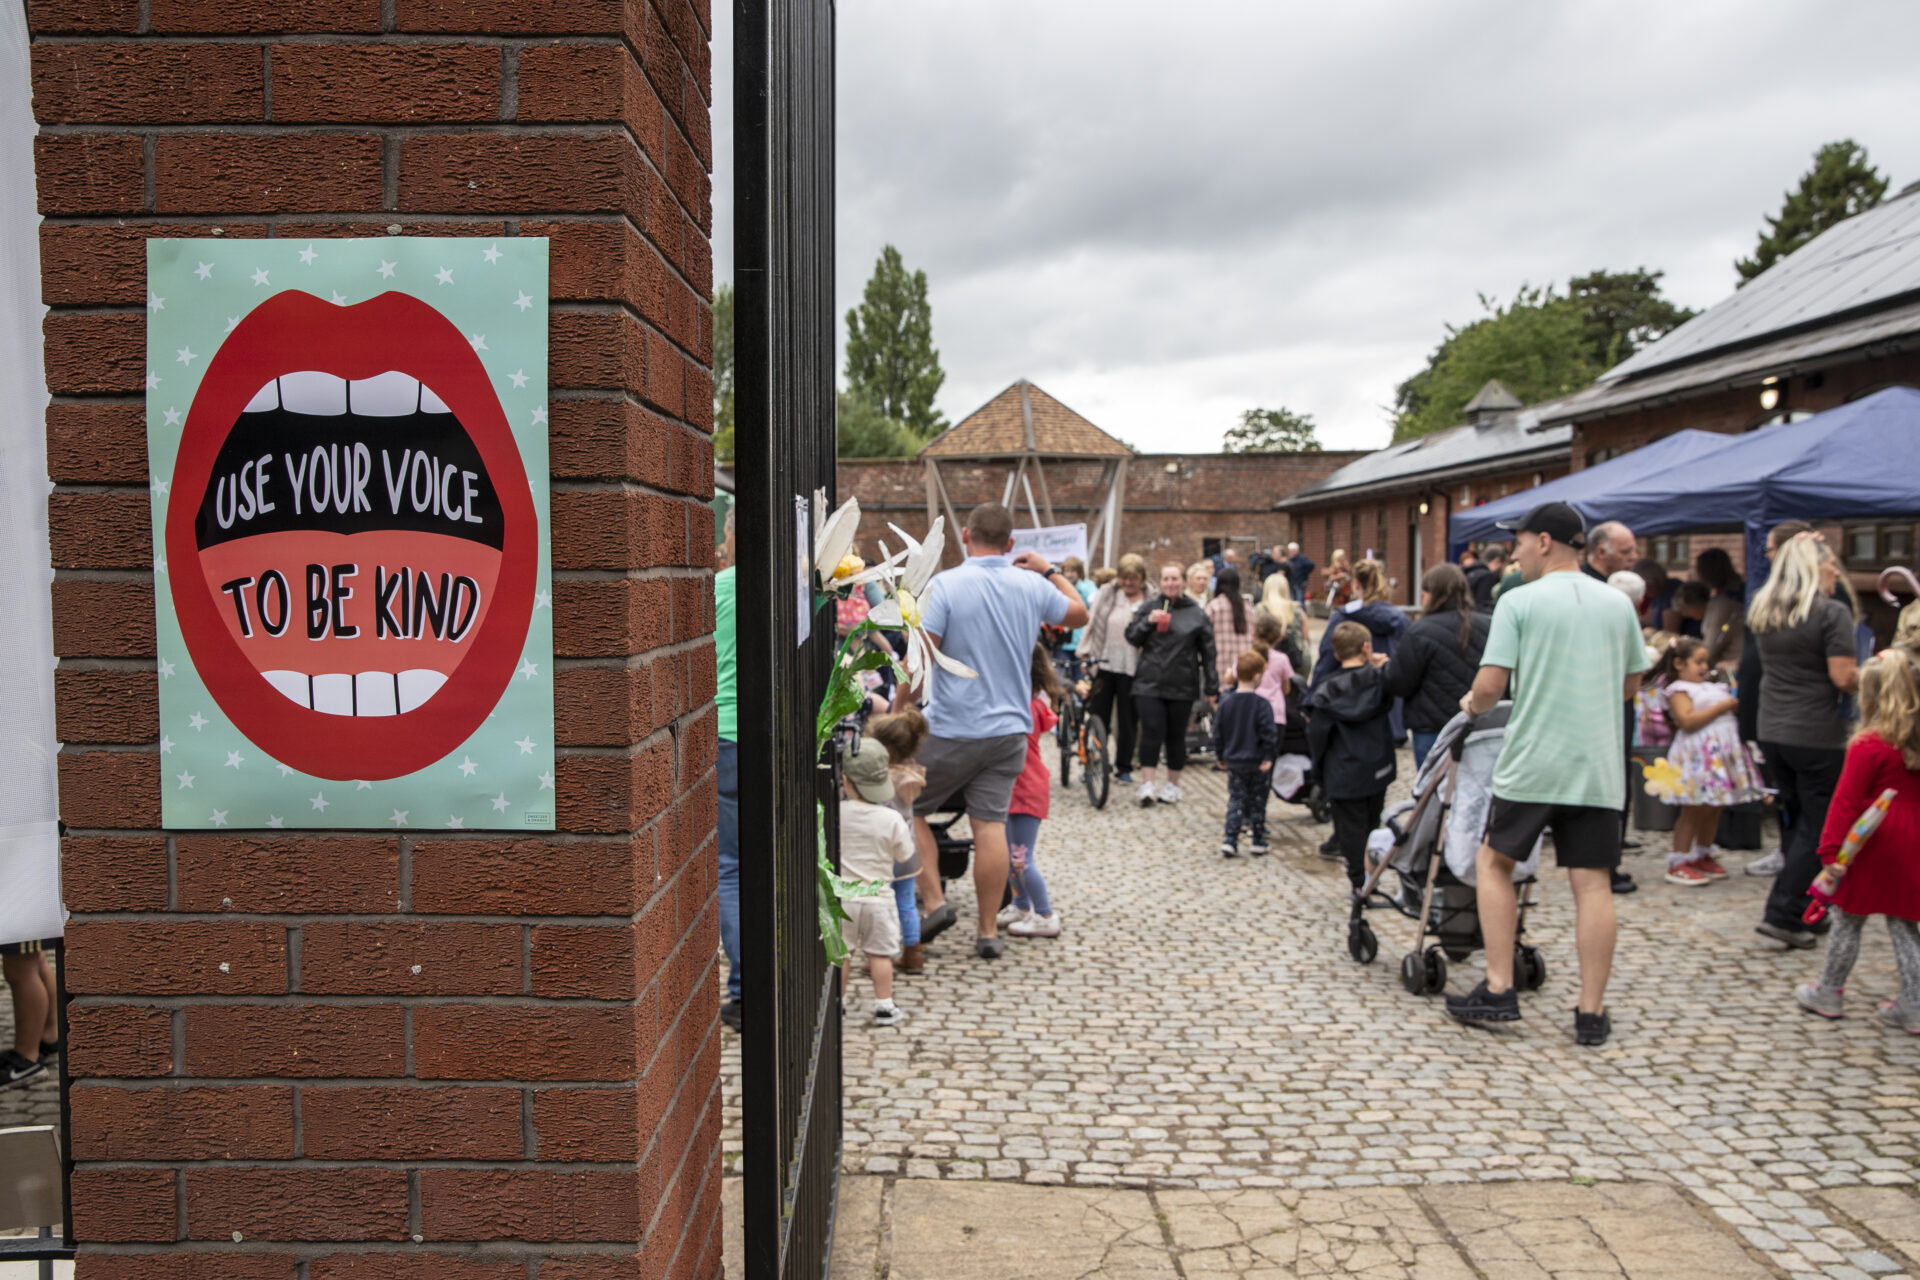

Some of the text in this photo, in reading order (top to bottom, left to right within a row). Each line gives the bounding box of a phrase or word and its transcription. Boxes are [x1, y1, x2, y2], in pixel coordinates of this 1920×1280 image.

[216, 442, 483, 529] USE YOUR VOICE
[221, 563, 480, 643] TO BE KIND
